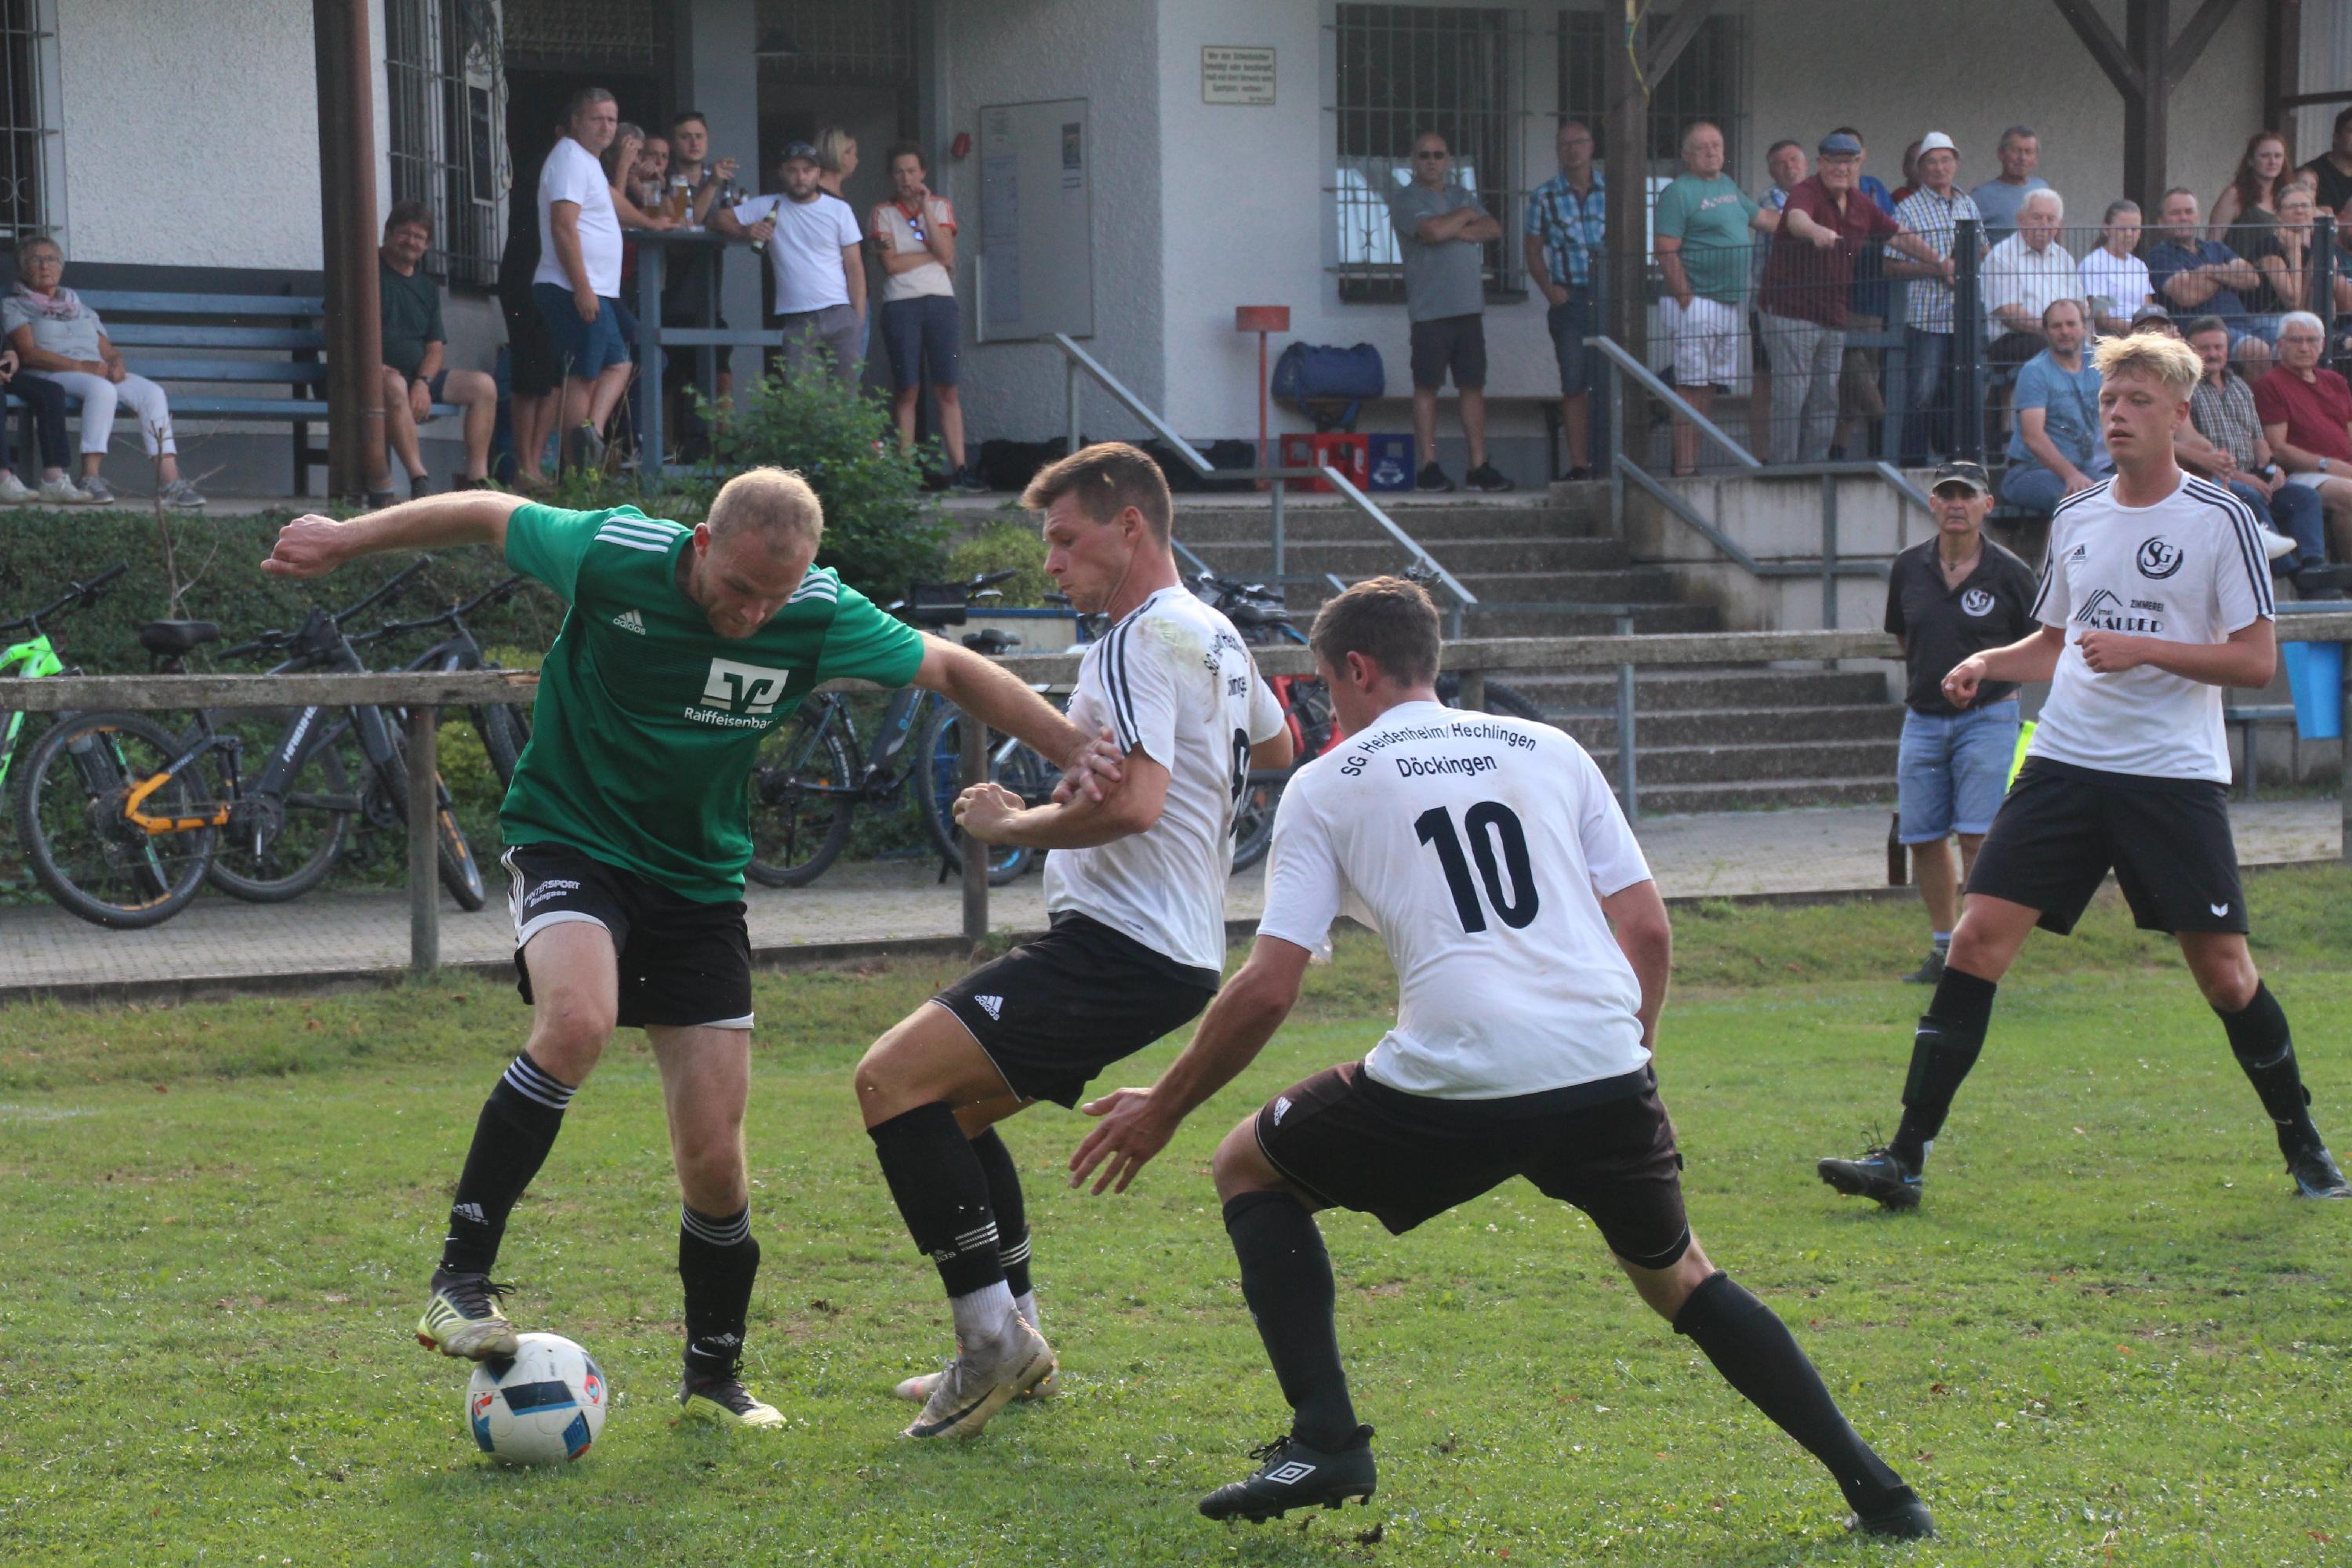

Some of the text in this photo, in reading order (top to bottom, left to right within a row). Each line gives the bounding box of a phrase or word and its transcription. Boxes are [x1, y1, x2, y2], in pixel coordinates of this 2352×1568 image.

[2144, 541, 2172, 567] SG
[613, 617, 647, 636] adidas
[1341, 722, 1537, 776] SG Heidenheim/Hechlingen
[1396, 754, 1497, 777] Döckingen
[1414, 801, 1539, 934] 10
